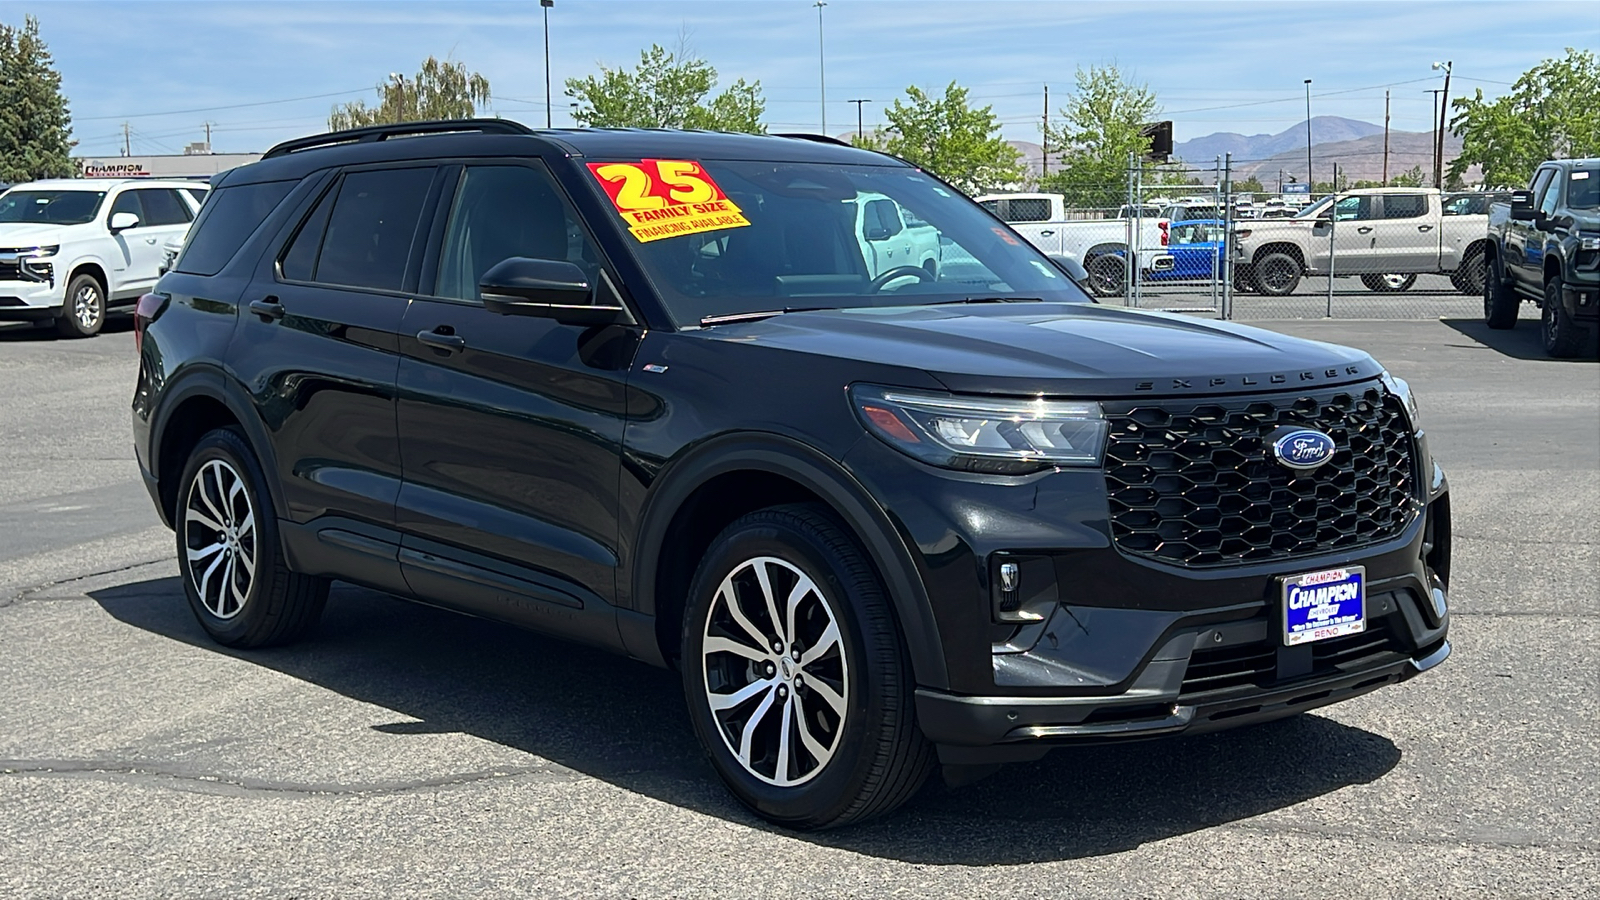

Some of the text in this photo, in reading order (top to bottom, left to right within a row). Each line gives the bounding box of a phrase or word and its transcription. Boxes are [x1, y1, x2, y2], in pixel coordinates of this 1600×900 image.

[85, 165, 143, 174] CHAMPION
[595, 161, 718, 209] 25
[632, 201, 729, 223] FAMILY SIZE
[635, 214, 745, 239] FINANCING AVAILABLE
[1135, 366, 1359, 390] EXPLORER
[1292, 438, 1325, 460] Ford
[1305, 571, 1342, 585] CHAMPION
[1289, 582, 1358, 610] CHAMPION
[1309, 606, 1337, 617] CHEVROLET
[1314, 627, 1339, 638] RENO
